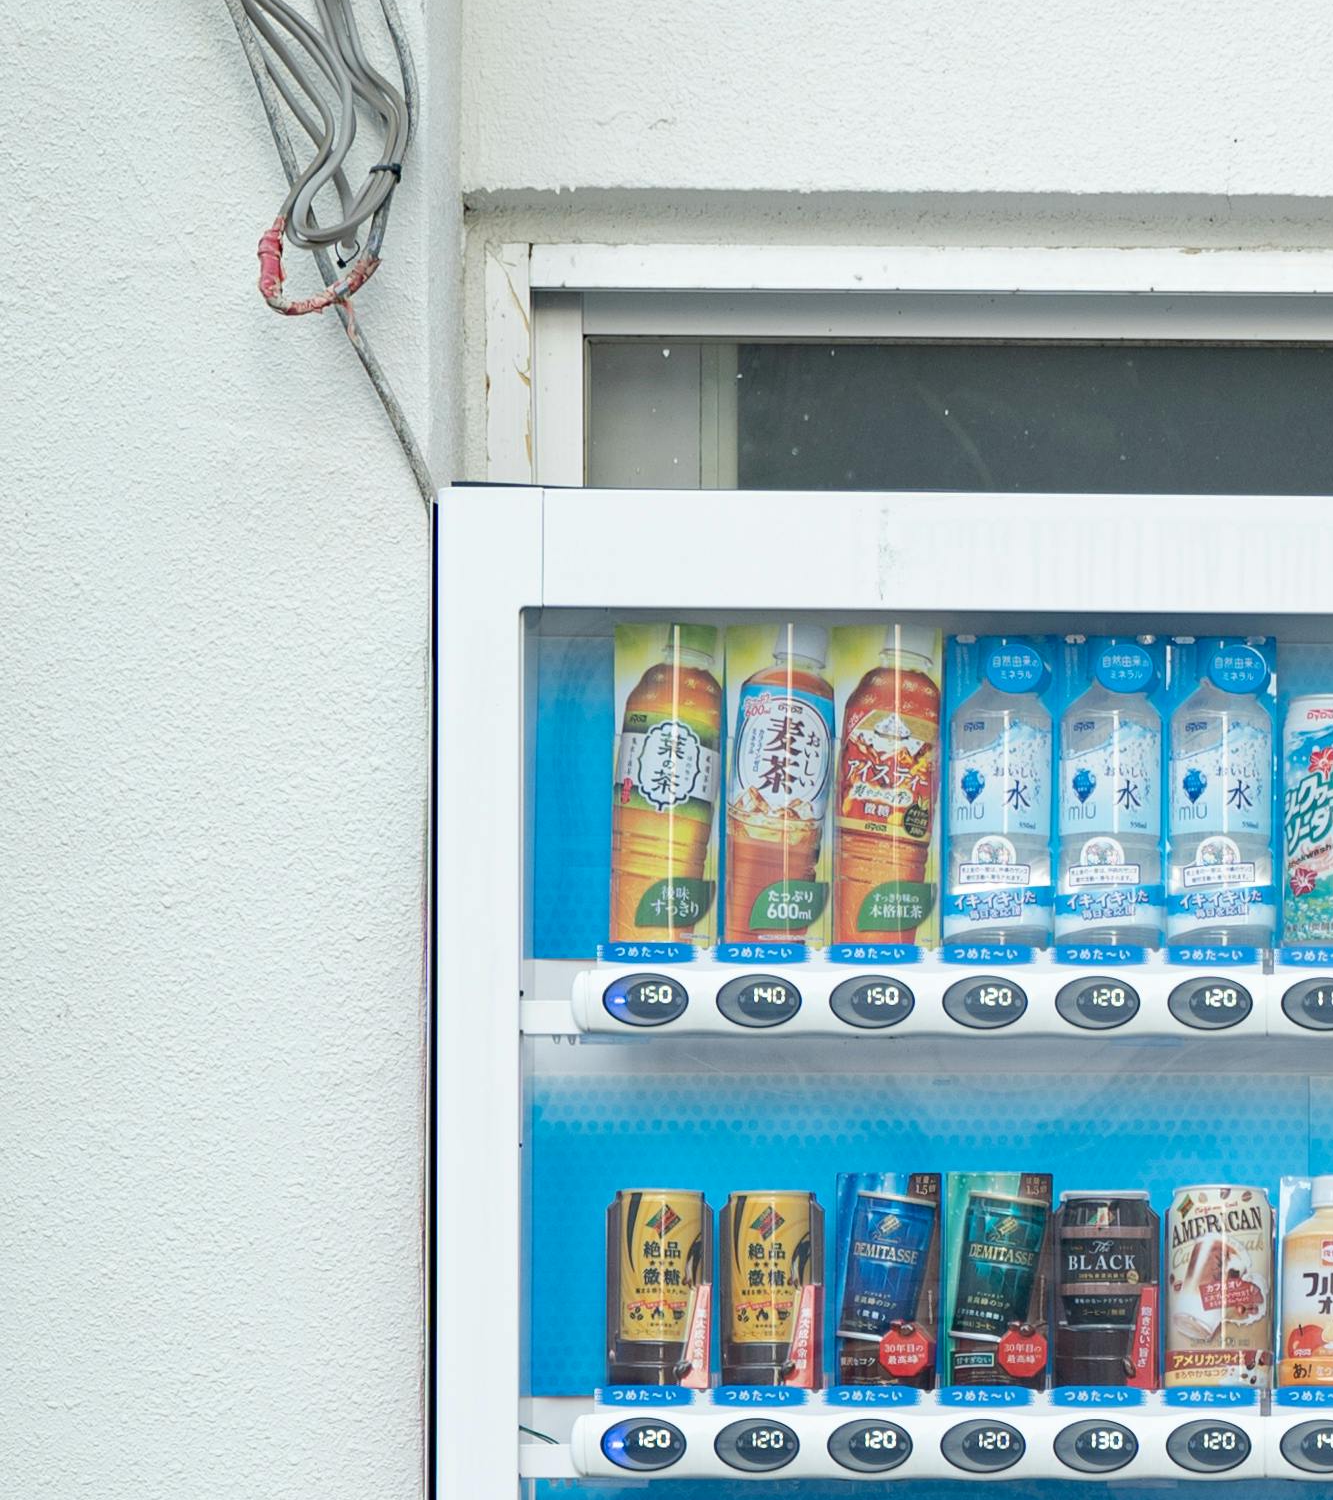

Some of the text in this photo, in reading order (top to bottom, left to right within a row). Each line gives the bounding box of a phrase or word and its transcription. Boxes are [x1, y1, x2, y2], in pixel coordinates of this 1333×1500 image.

[652, 731, 685, 796] 葉の茶
[759, 717, 804, 795] 麦茶
[805, 731, 821, 789] おいしい
[766, 890, 813, 903] たっぷり
[651, 900, 699, 918] すっきり
[767, 905, 812, 921] 600ml
[869, 905, 922, 918] 本格紅茶
[640, 986, 672, 1004] 150
[754, 986, 786, 1004] 140
[1092, 988, 1124, 1006] 120
[643, 1241, 682, 1259] 絶品
[748, 1241, 786, 1260] 絶品
[853, 1242, 919, 1265] DEMITASSE
[969, 1243, 1035, 1266] DEMITASSE
[1068, 1254, 1136, 1271] BLACK
[638, 1430, 670, 1448] 120
[1092, 1430, 1122, 1450] 130
